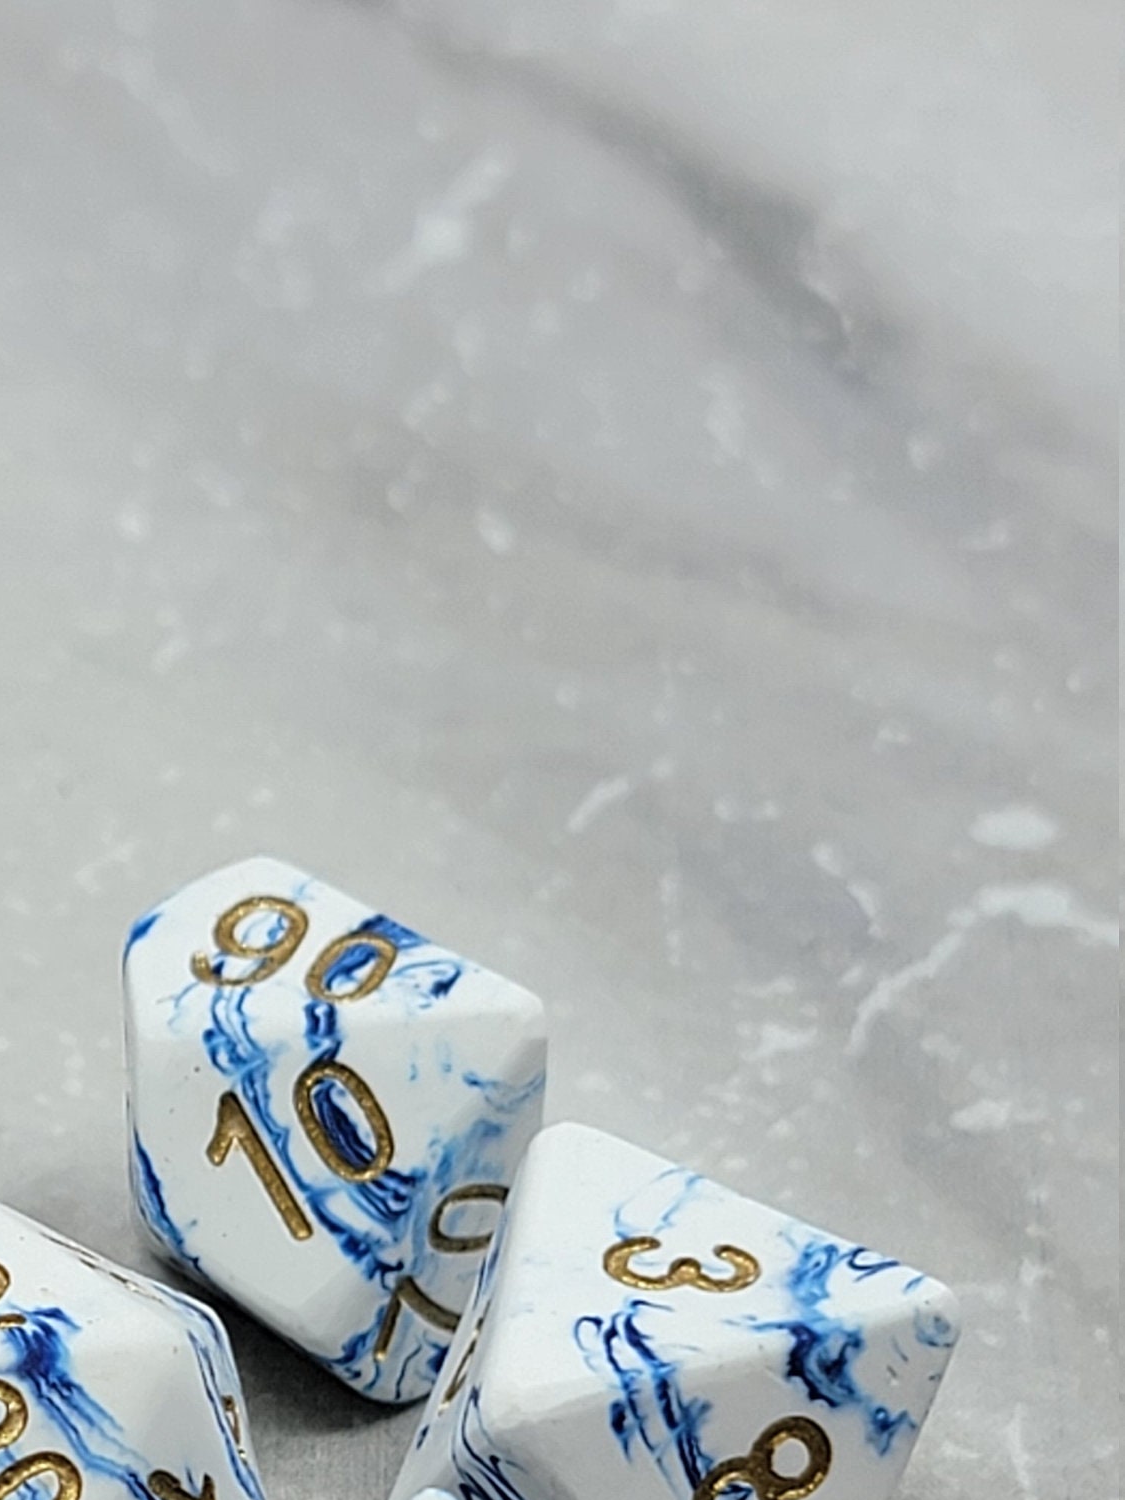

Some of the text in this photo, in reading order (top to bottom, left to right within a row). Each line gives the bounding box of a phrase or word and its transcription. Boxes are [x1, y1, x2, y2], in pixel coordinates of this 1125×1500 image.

[190, 896, 398, 1003] 90
[205, 1060, 396, 1241] 10
[602, 1236, 762, 1293] 3
